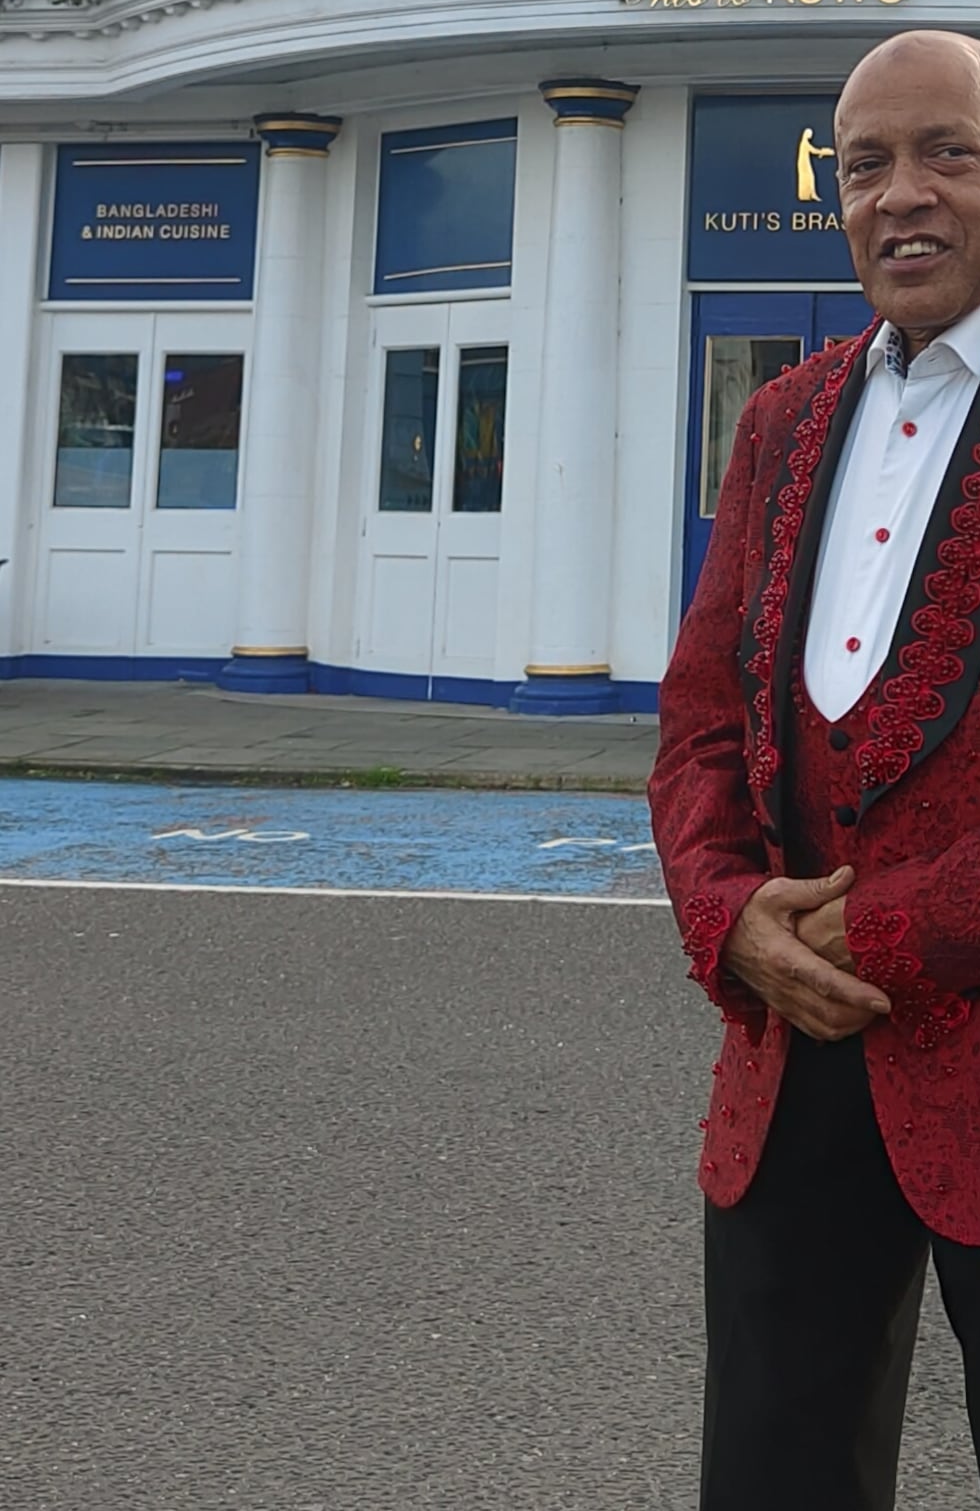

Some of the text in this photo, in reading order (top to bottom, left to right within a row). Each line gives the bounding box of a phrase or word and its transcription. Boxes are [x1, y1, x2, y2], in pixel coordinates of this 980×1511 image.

[96, 204, 218, 218] BANGLADESHI
[705, 212, 780, 231] KUTI'S
[81, 224, 231, 239] & INDIAN CUISINE
[150, 828, 311, 842] NO
